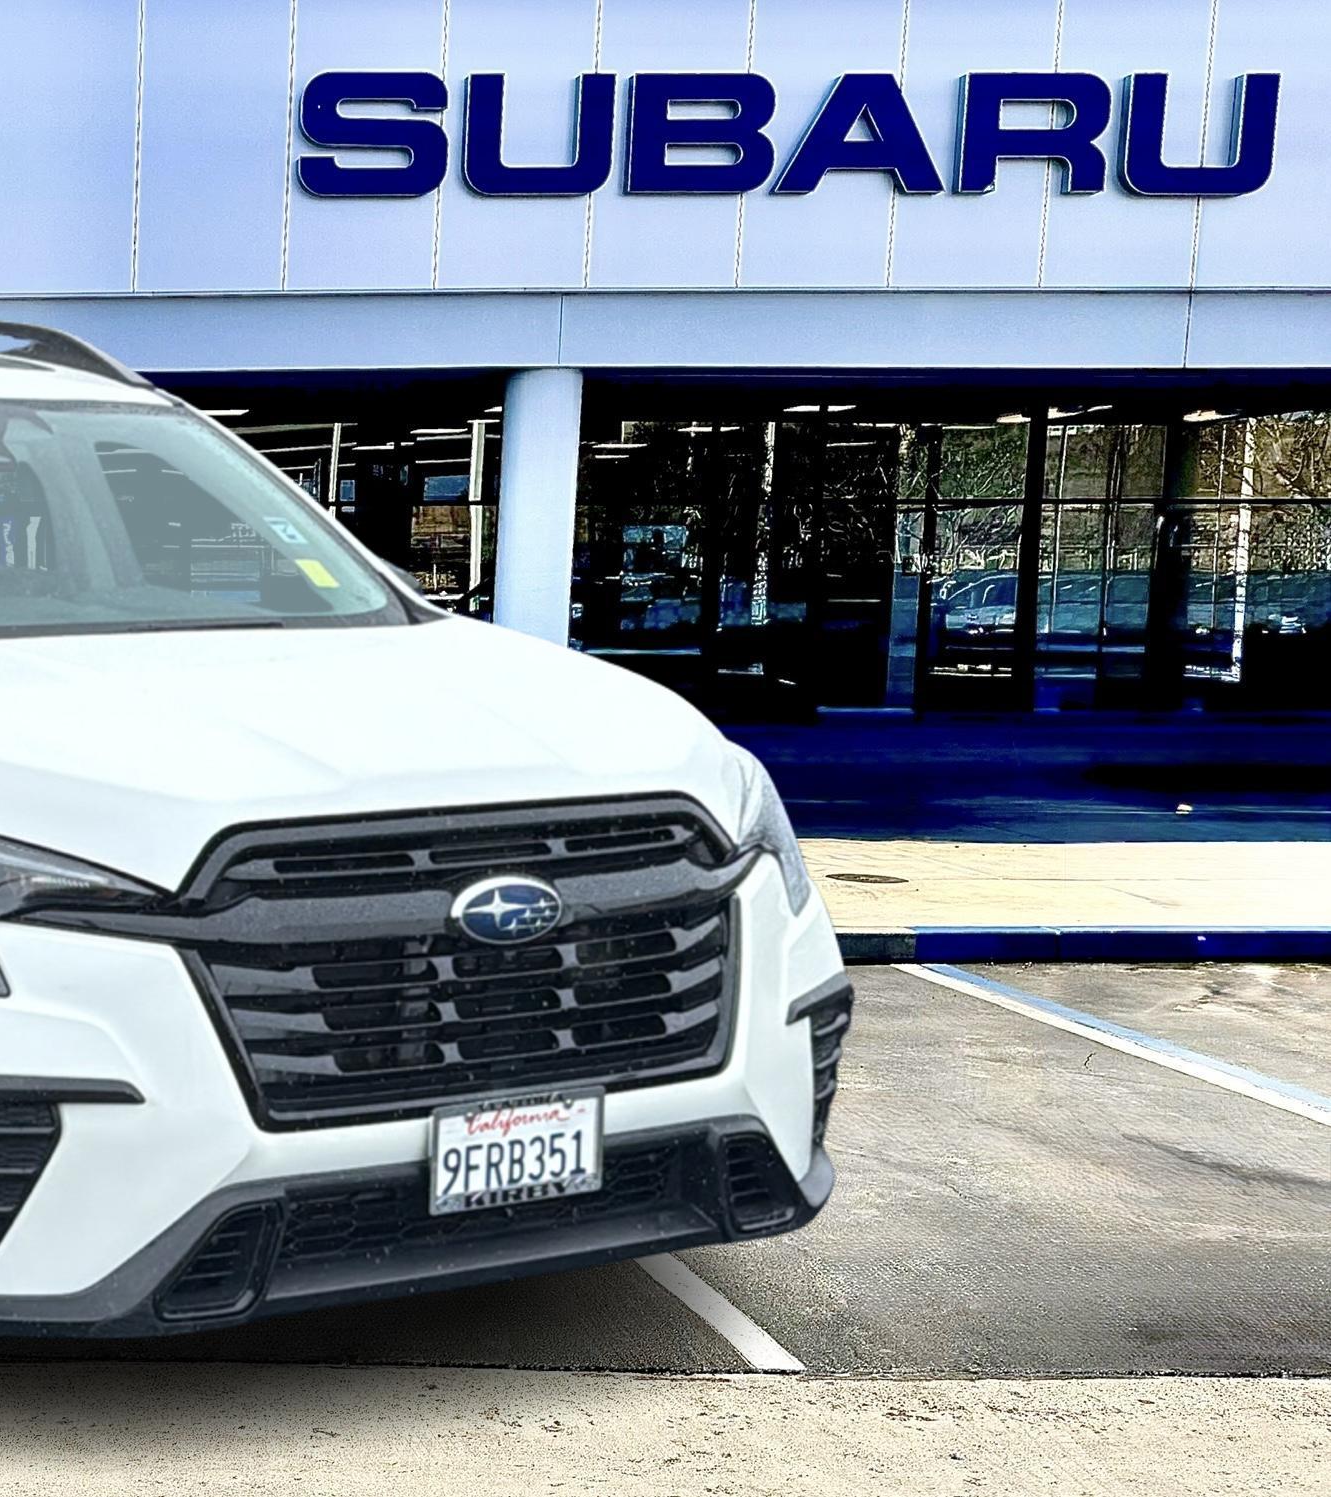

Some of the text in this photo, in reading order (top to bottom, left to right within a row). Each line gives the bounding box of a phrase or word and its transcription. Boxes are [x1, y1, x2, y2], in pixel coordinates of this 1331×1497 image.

[297, 71, 1280, 198] SUBARU
[467, 1106, 570, 1136] California
[443, 1130, 586, 1197] 9FRB351
[464, 1181, 570, 1207] KIRBY
